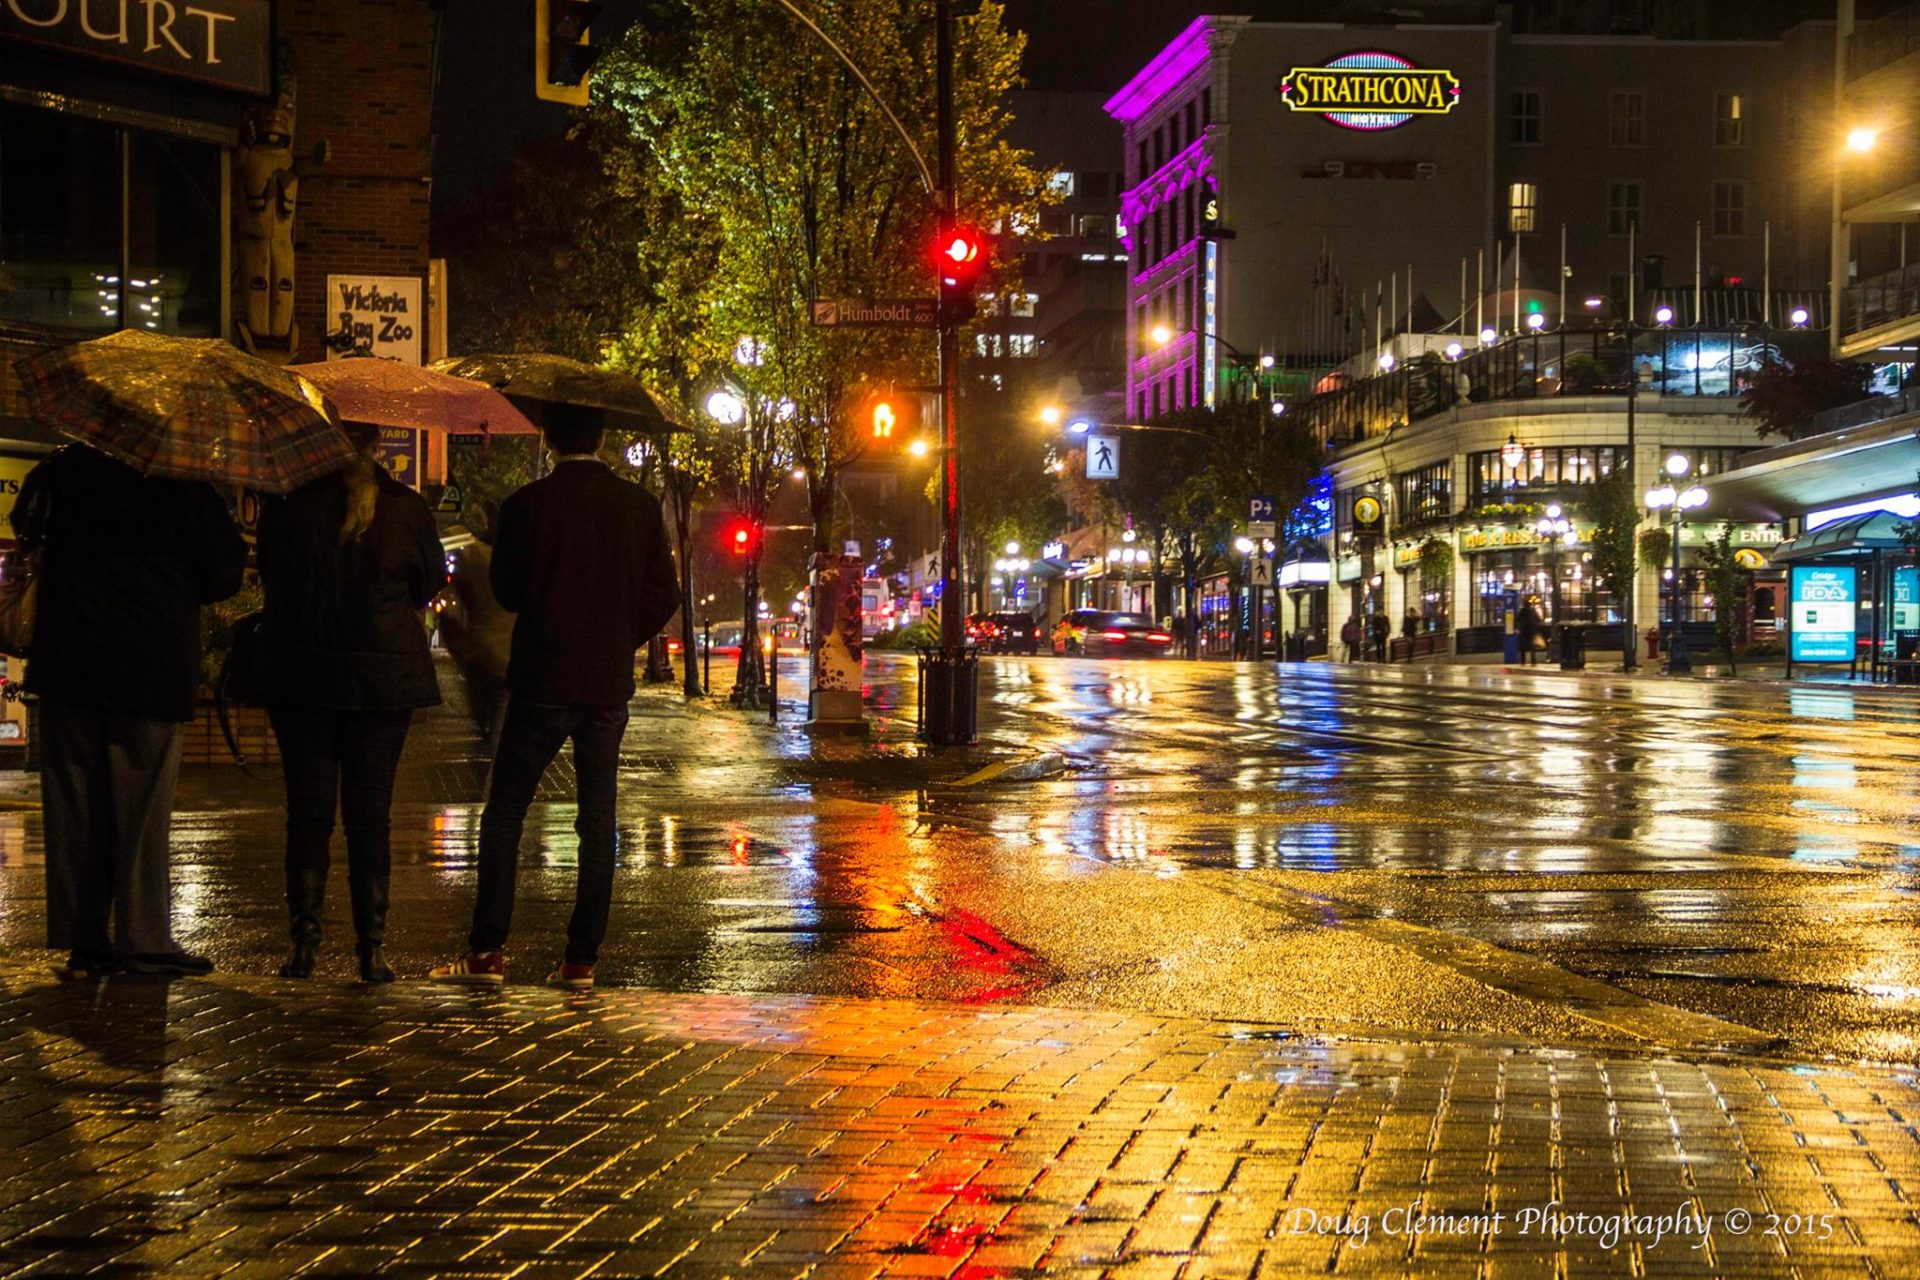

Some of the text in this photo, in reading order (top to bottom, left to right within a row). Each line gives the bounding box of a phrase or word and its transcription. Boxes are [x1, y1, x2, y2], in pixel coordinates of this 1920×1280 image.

[1295, 72, 1446, 107] STRATHCONA
[1350, 113, 1394, 124] HOTEL
[339, 284, 408, 313] Victoria
[840, 305, 911, 321] Humboldt
[339, 312, 413, 349] Bug Zoo
[1250, 499, 1263, 518] P
